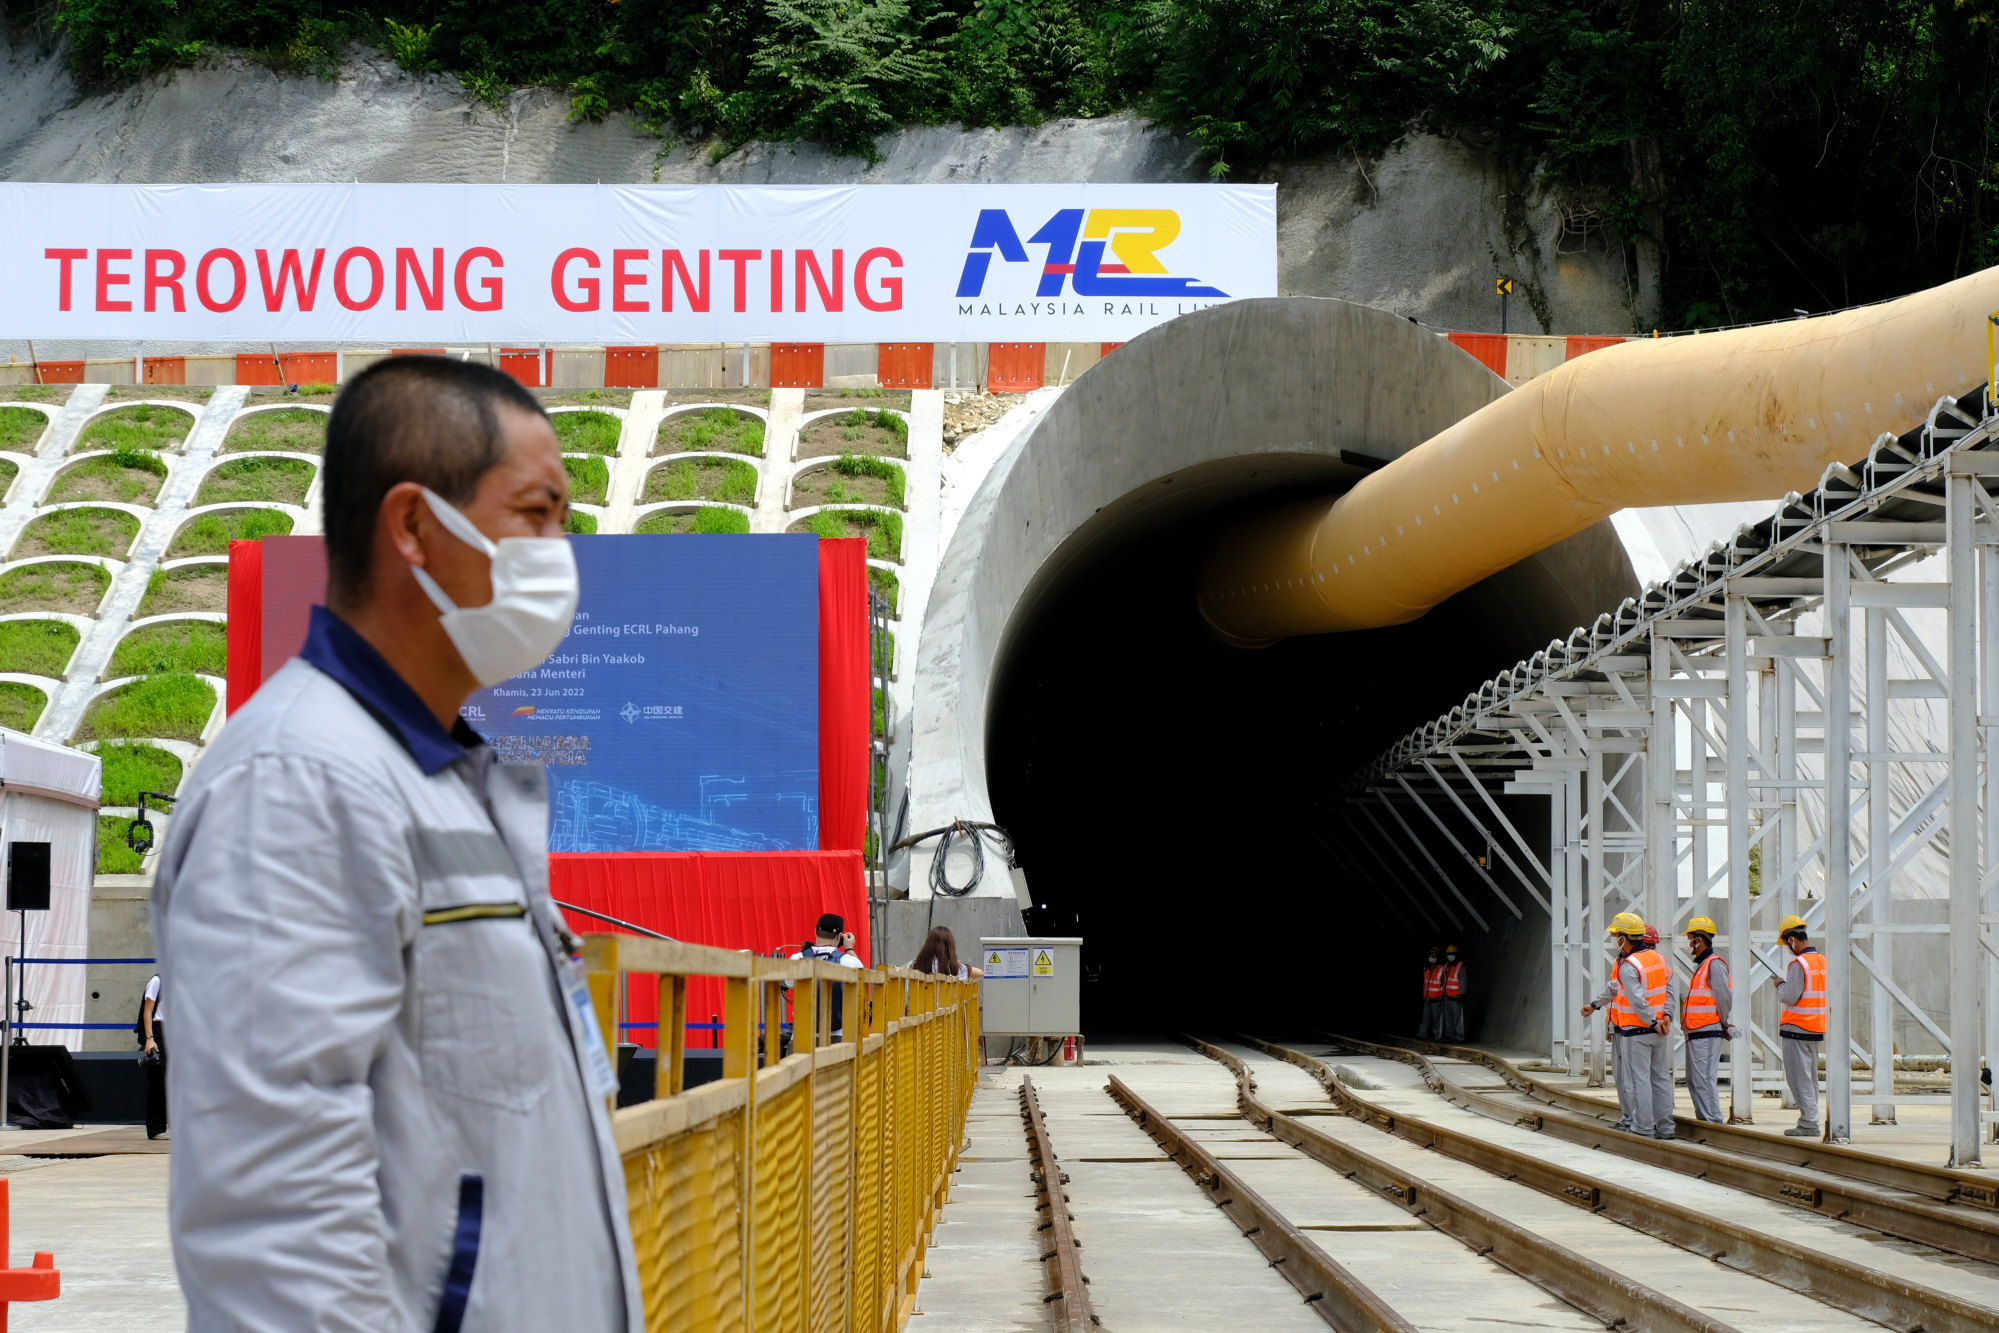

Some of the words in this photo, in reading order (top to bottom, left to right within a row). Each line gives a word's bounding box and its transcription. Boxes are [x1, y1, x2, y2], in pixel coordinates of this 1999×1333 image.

[44, 246, 504, 313] TEROWONG
[551, 247, 903, 313] GENTING
[958, 302, 1085, 316] MALAYSIA
[1104, 302, 1159, 316] RAIL
[573, 624, 621, 637] Genting
[623, 624, 653, 635] ECRL
[655, 623, 699, 637] Pahang
[548, 653, 579, 664] Sabri
[581, 653, 600, 664] Bin
[602, 653, 645, 664] Yaakob
[540, 667, 586, 679] Menteri
[493, 688, 529, 697] Khamis,
[531, 688, 542, 697] 23
[544, 688, 560, 697] Jun
[562, 688, 585, 697] 2022
[459, 705, 486, 717] CRL
[643, 705, 683, 715] 中国交建
